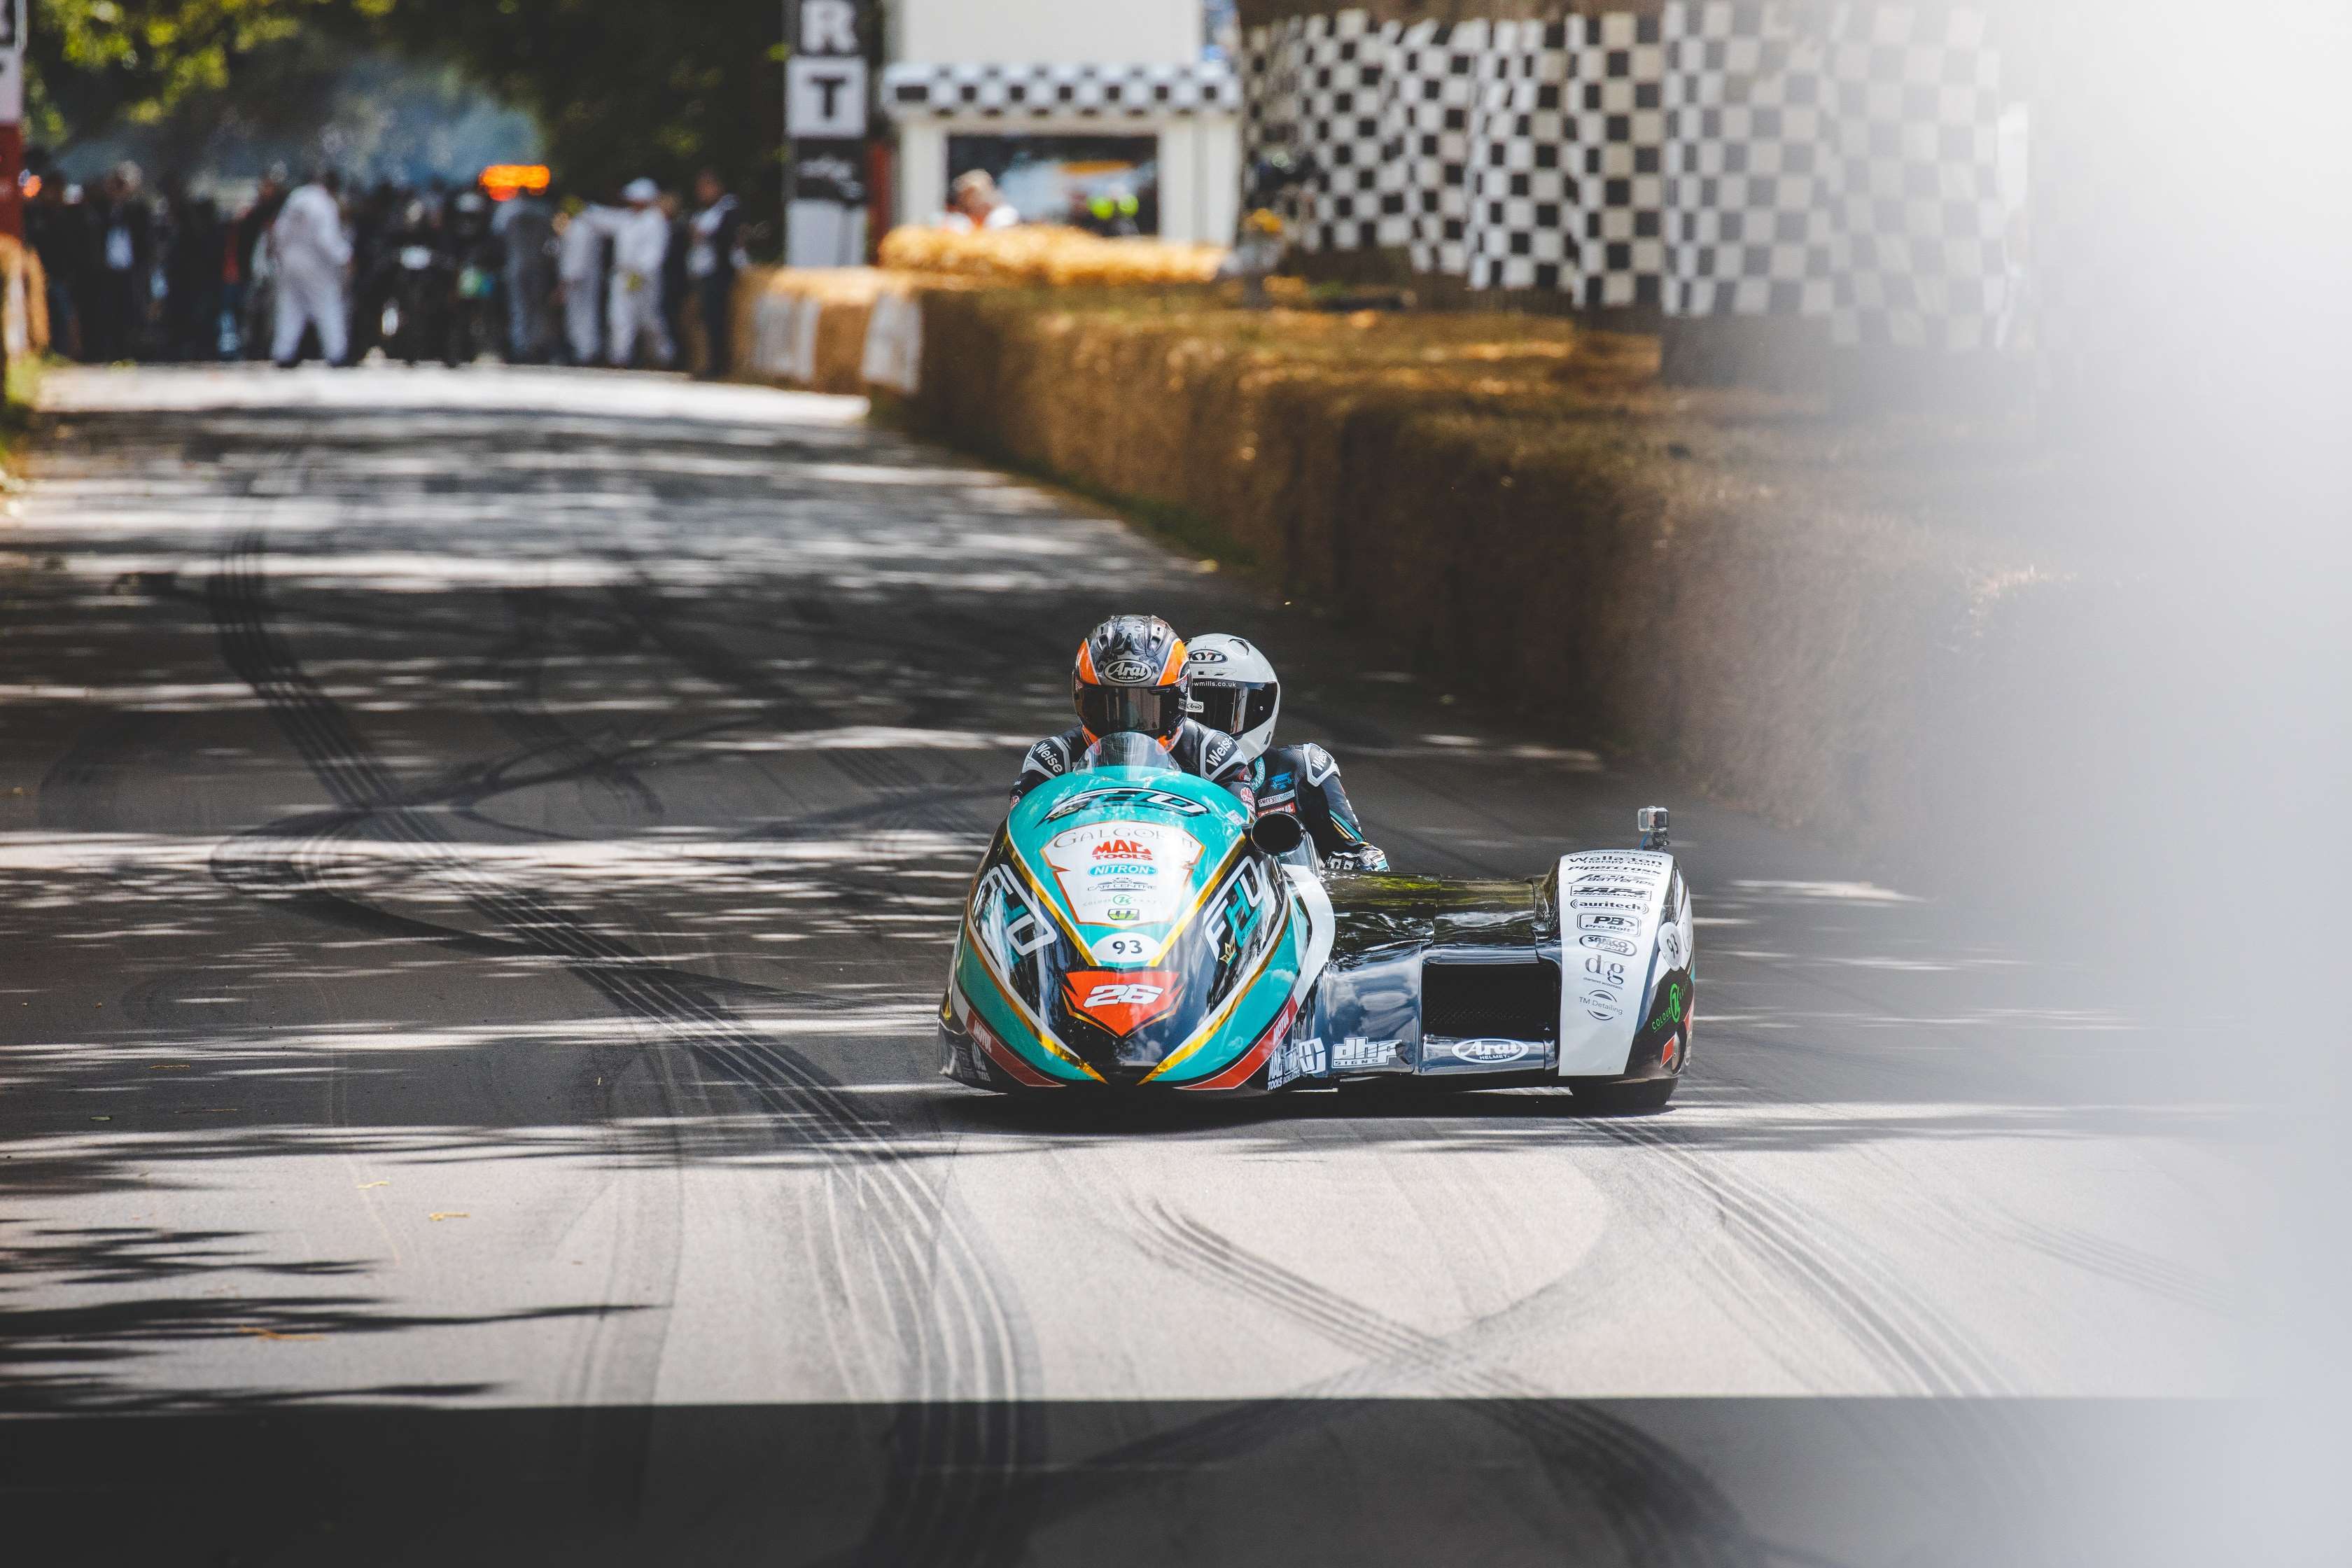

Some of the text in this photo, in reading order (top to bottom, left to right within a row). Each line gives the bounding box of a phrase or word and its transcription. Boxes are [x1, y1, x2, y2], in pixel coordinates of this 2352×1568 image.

[1111, 662, 1147, 677] Arai
[1035, 742, 1063, 773] Weise
[1206, 737, 1233, 767] Weise
[1092, 839, 1153, 855] MAC
[1569, 856, 1662, 865] Wollaton
[1094, 865, 1150, 875] NITRON
[1579, 901, 1641, 910] auritech
[1112, 940, 1142, 954] 93
[1666, 933, 1679, 958] 93
[1585, 954, 1625, 985] drg
[1083, 983, 1165, 1008] 26
[1579, 996, 1623, 1016] TM Detailing
[1652, 1007, 1672, 1030] COLOUR
[1460, 1041, 1522, 1056] Arai
[1267, 1077, 1283, 1091] TOOLS
